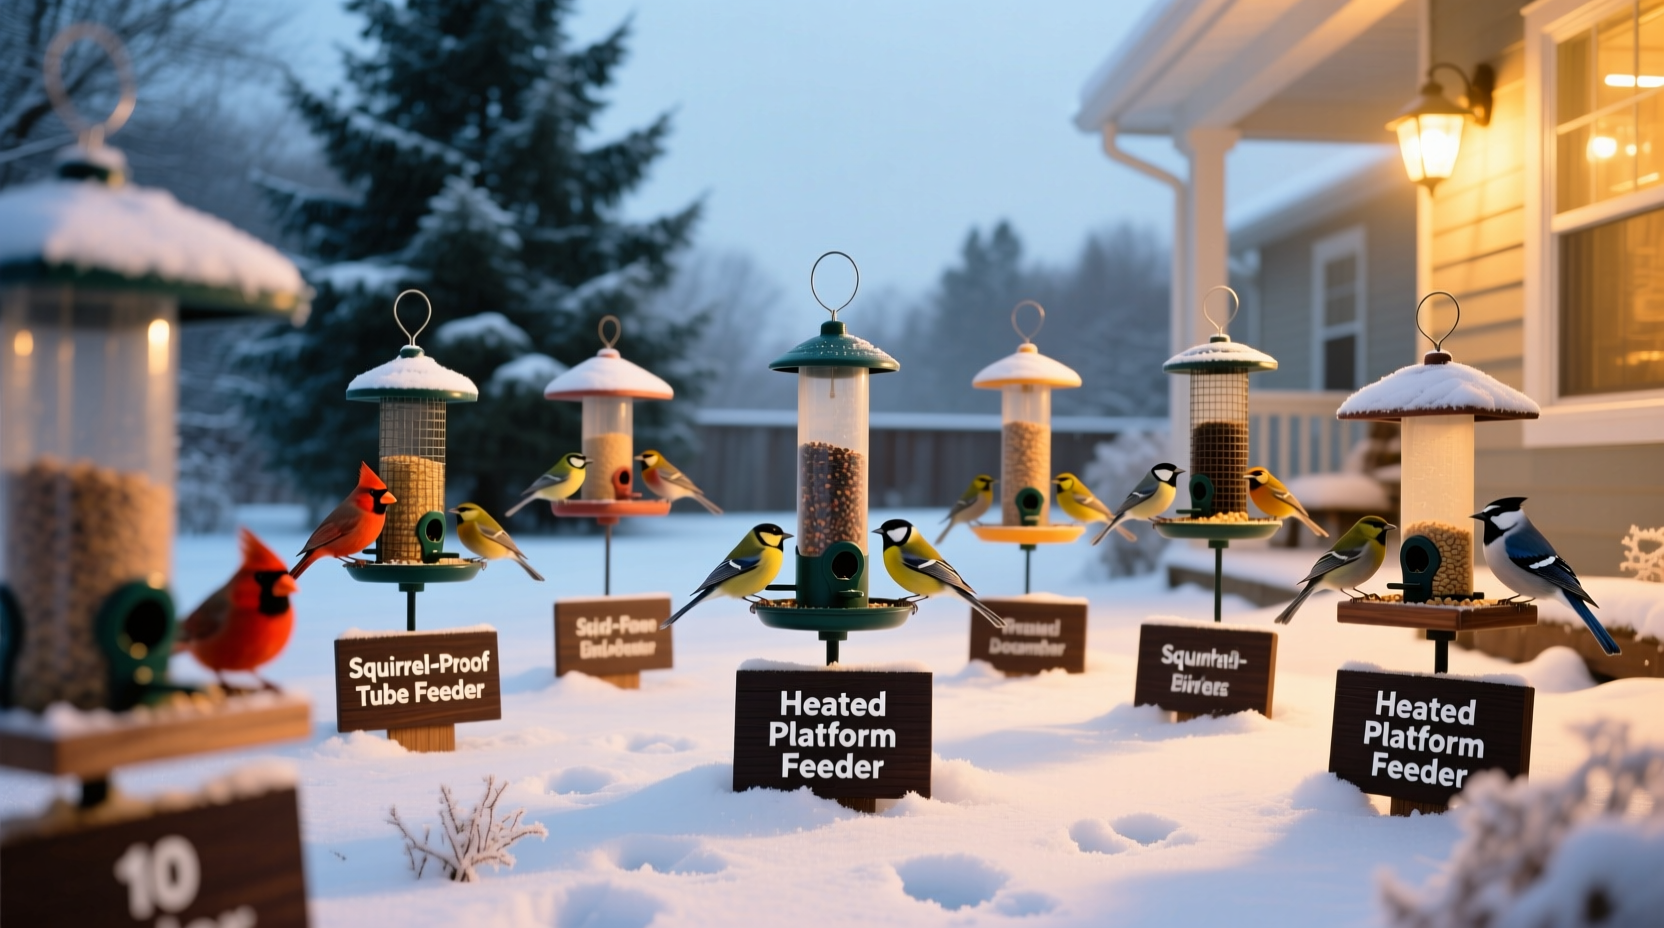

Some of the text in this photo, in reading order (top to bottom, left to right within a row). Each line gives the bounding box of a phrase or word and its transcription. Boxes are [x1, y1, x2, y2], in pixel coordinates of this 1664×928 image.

[349, 650, 490, 683] Squirrel-Proof
[355, 679, 485, 707] Tube Feeder
[780, 690, 886, 717] Heated
[1375, 690, 1476, 726] Heated
[769, 721, 896, 748] Platform
[1363, 720, 1484, 758] Platform
[782, 752, 884, 779] Feeder
[1371, 751, 1468, 788] Feeder
[113, 834, 201, 921] 10
